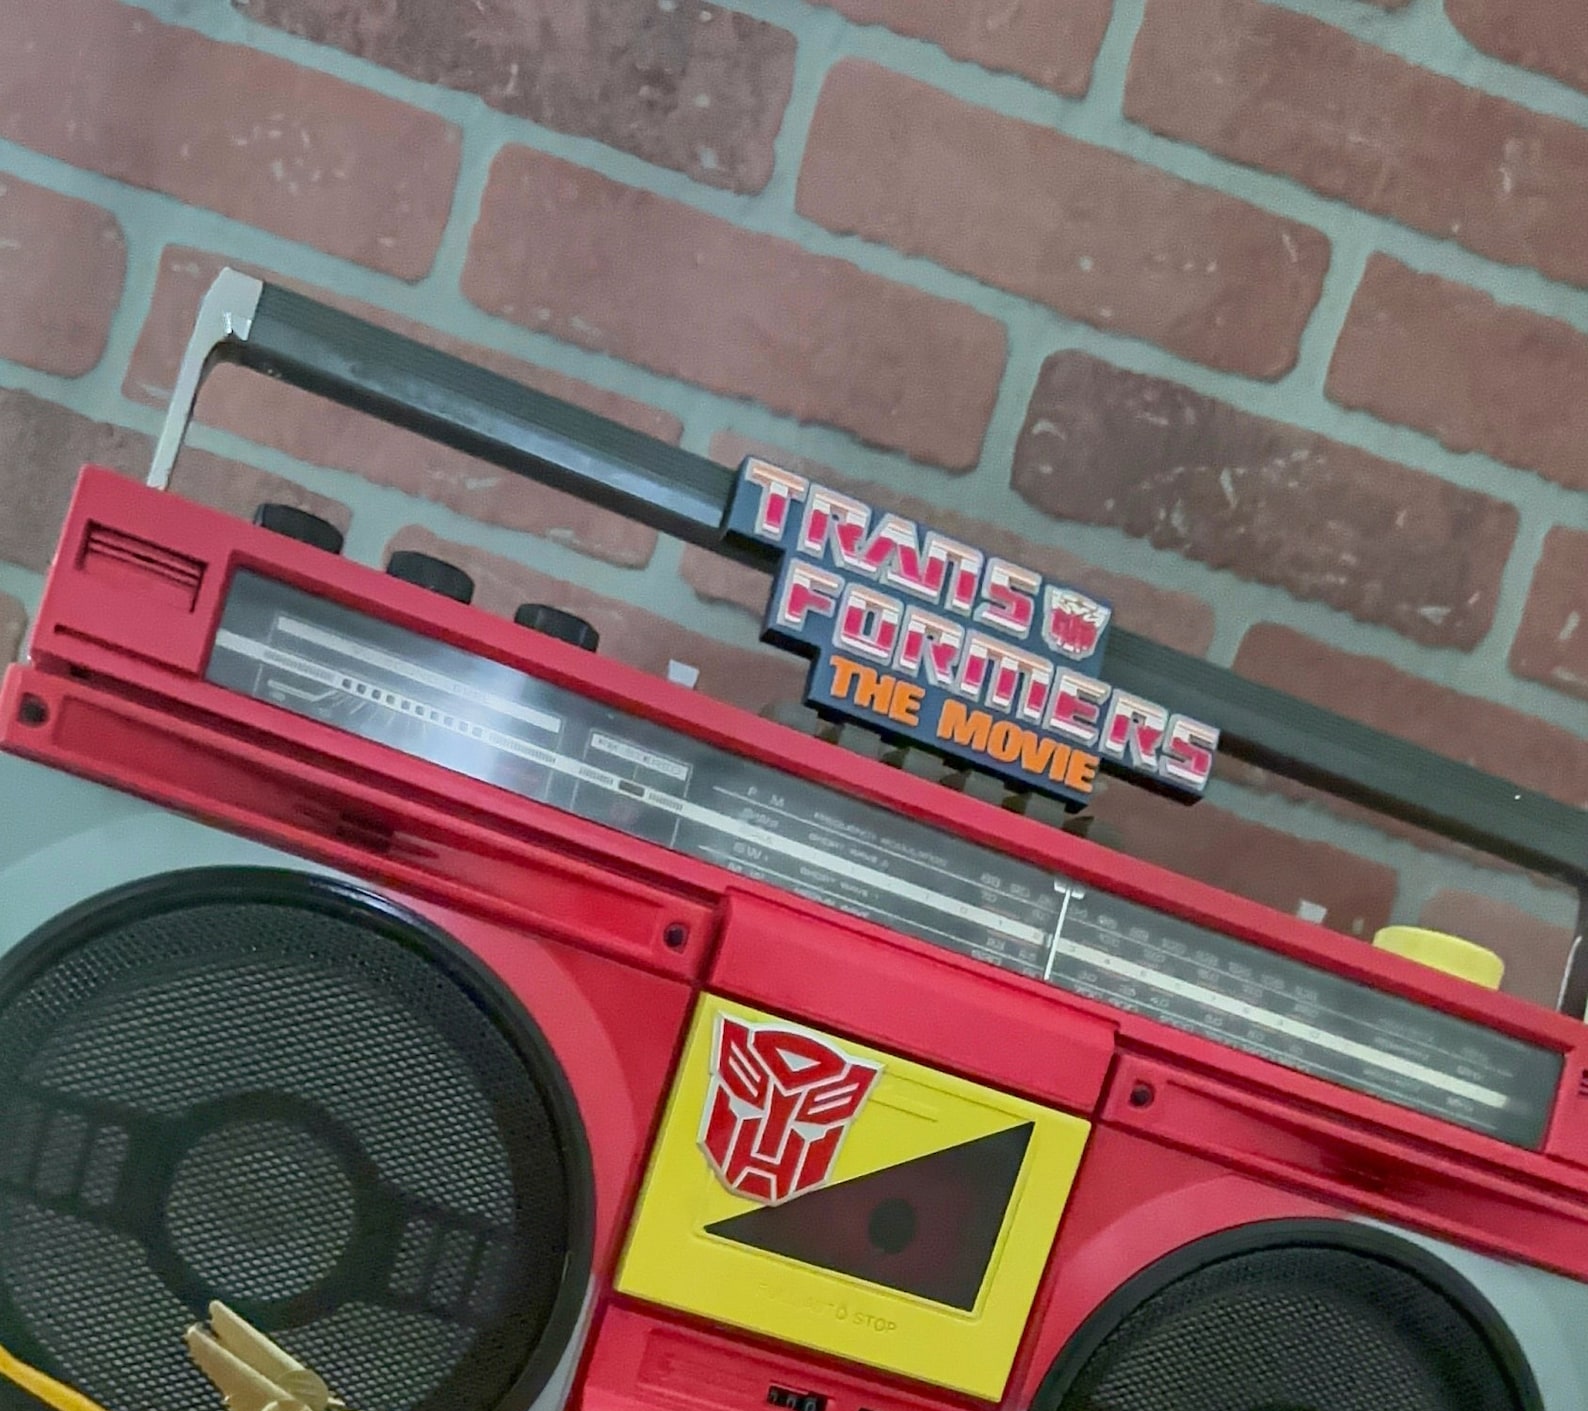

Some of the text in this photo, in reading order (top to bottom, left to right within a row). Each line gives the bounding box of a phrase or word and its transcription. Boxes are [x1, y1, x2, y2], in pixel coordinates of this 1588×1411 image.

[745, 456, 1043, 639] TRANS
[777, 558, 1220, 791] FORMERS
[830, 655, 1100, 793] THE MOVIE
[851, 1312, 897, 1333] STOP
